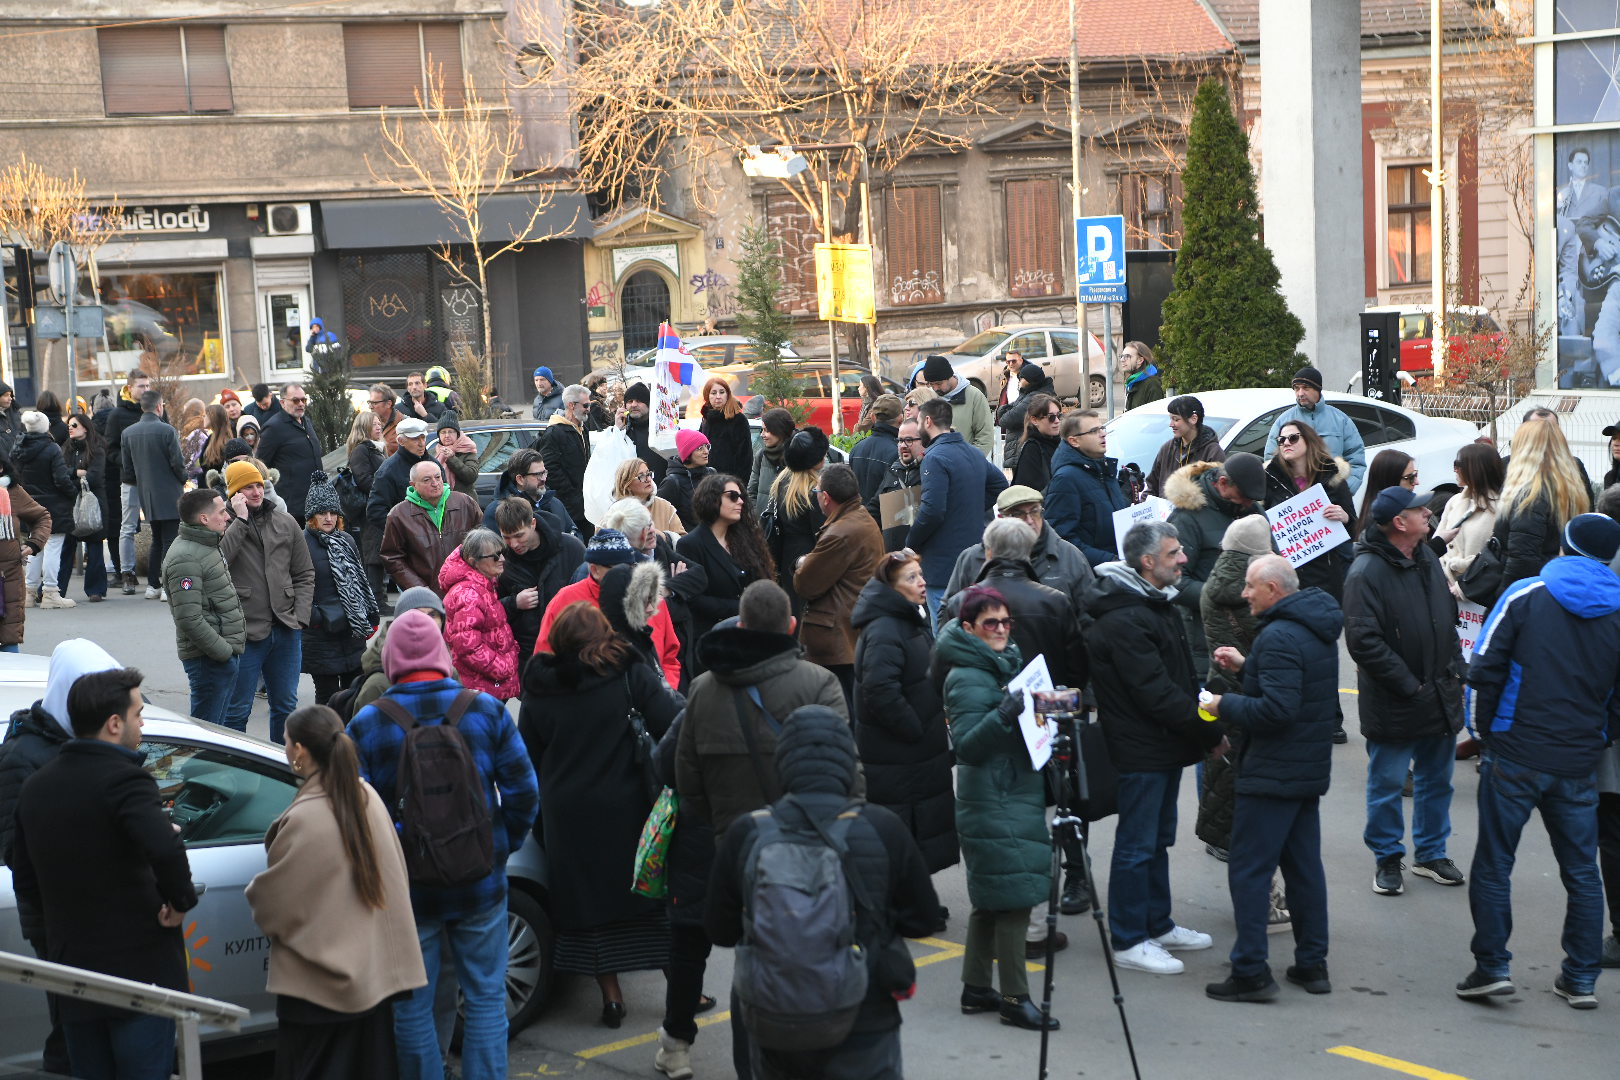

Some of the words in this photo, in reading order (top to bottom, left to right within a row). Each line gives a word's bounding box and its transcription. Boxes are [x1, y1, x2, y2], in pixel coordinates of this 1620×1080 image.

[1278, 505, 1293, 518] АКО
[1283, 498, 1324, 526] ПРАВДЕ
[1275, 532, 1287, 541] ЗА
[1287, 516, 1314, 534] НАРОД
[1287, 529, 1310, 544] НЕКА
[1279, 543, 1303, 558] ЕМА
[1303, 526, 1332, 546] МИРА
[1290, 553, 1302, 563] ЗА
[1303, 540, 1325, 557] ХУЉЕ
[1459, 610, 1484, 623] АВДЕ
[225, 936, 271, 956] КУЛТУ
